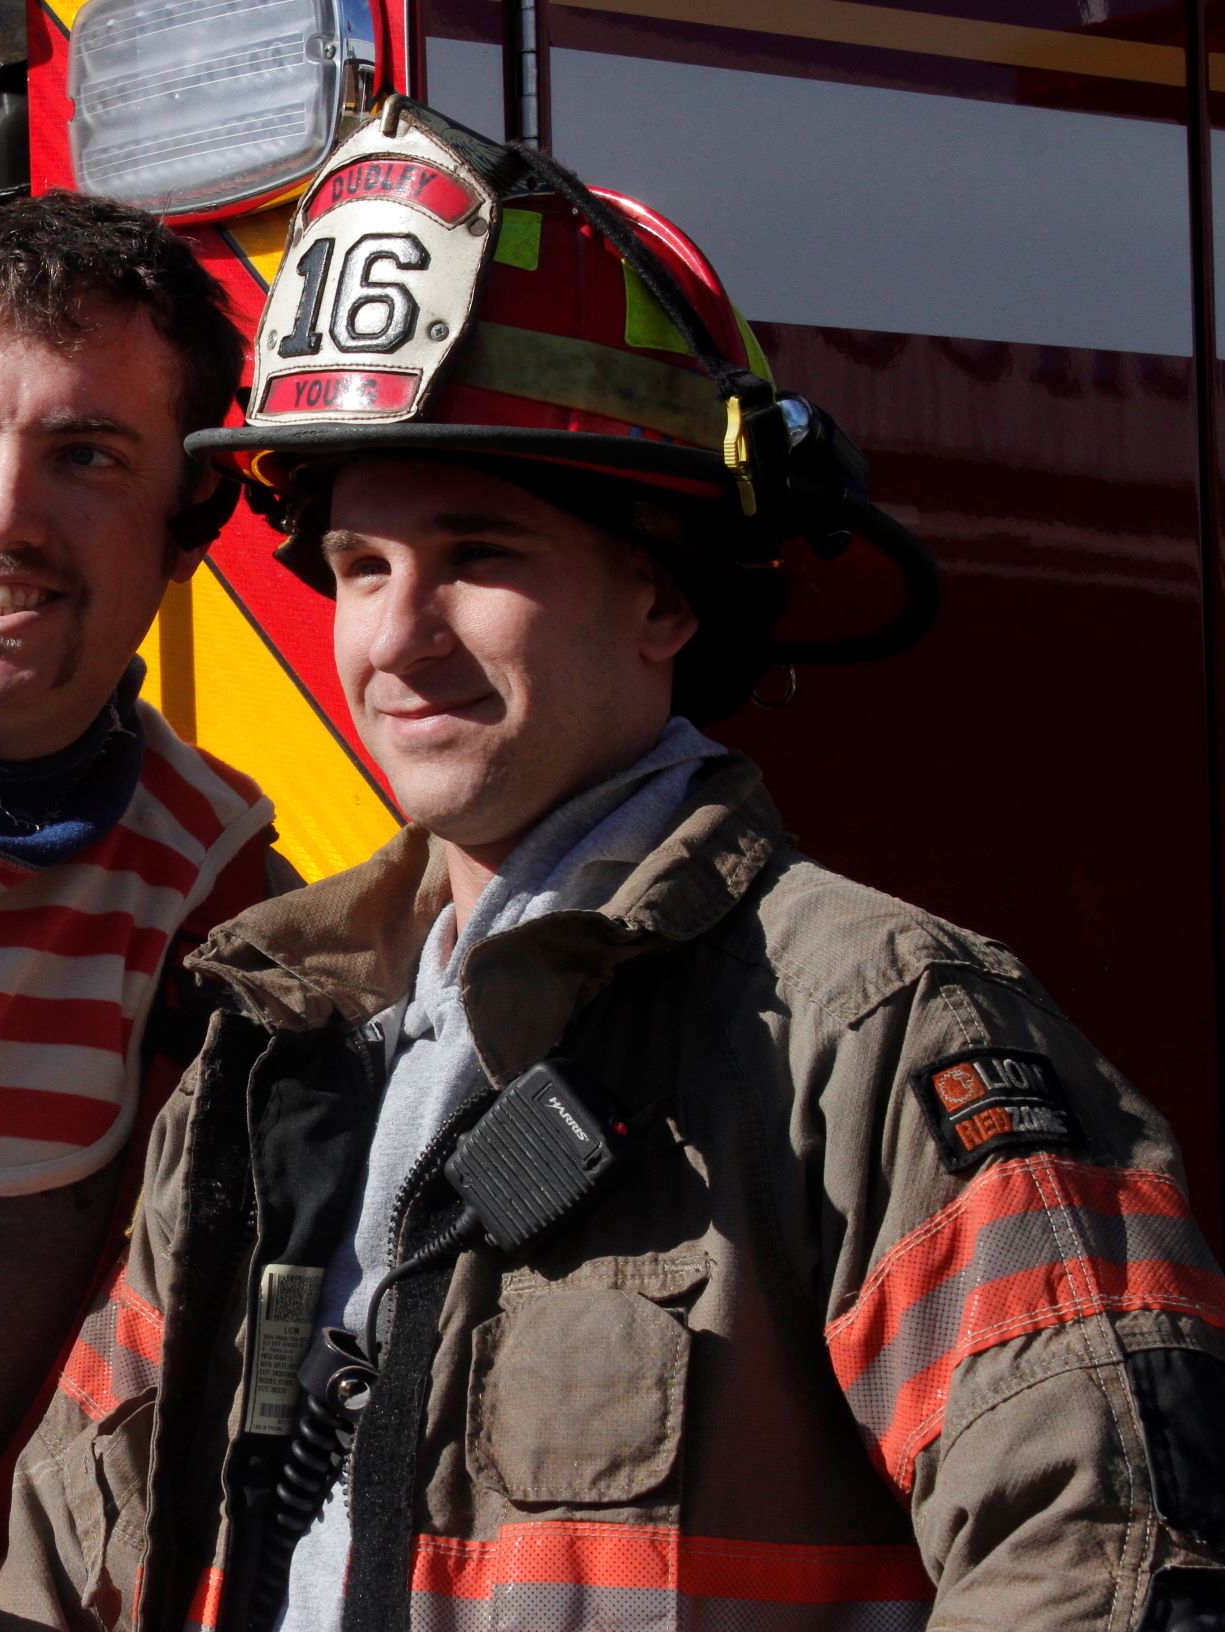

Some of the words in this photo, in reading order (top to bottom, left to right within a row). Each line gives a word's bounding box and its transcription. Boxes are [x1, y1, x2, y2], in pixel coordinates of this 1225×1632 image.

[331, 162, 438, 203] DUDLEY
[278, 232, 432, 358] 16
[294, 378, 378, 408] YOUG
[545, 1096, 589, 1141] HARRIS
